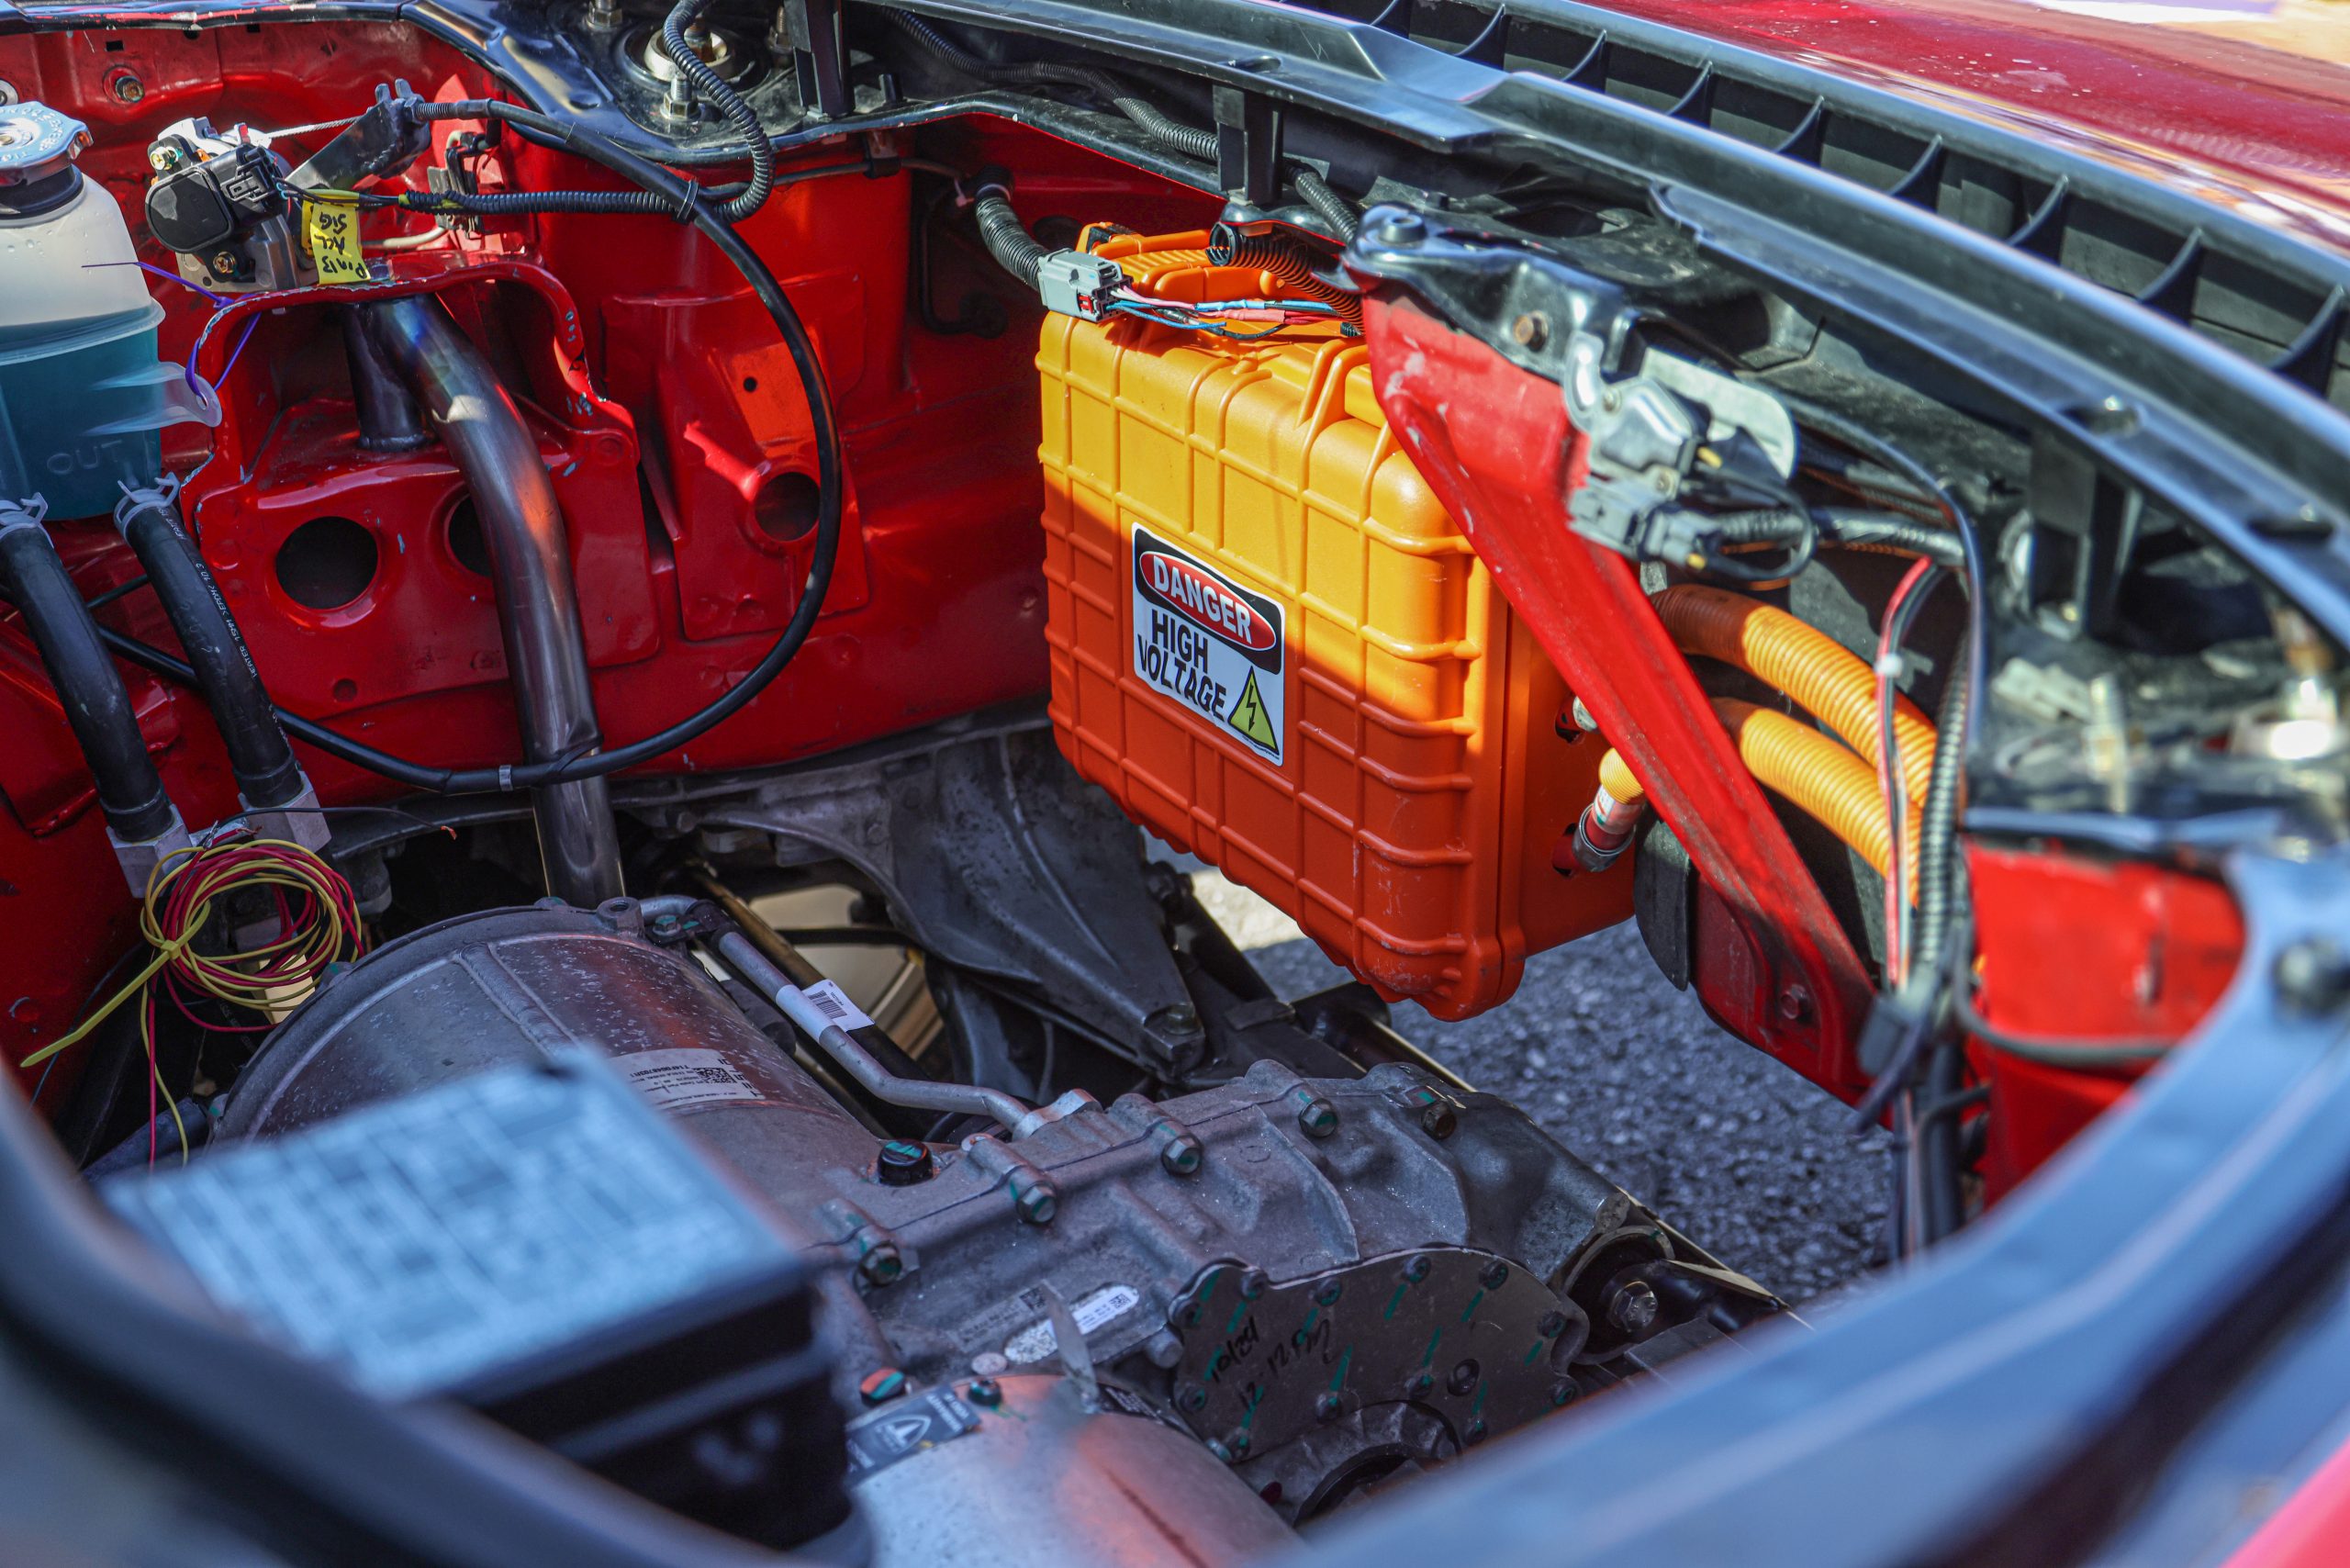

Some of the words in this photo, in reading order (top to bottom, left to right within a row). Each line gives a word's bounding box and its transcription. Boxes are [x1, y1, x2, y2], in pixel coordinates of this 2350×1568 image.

[47, 440, 122, 475] OUT
[1153, 554, 1252, 644] DANGER
[240, 644, 258, 678] HEATER
[1152, 610, 1209, 674] HIGH
[1138, 633, 1227, 723] VOLTAGE
